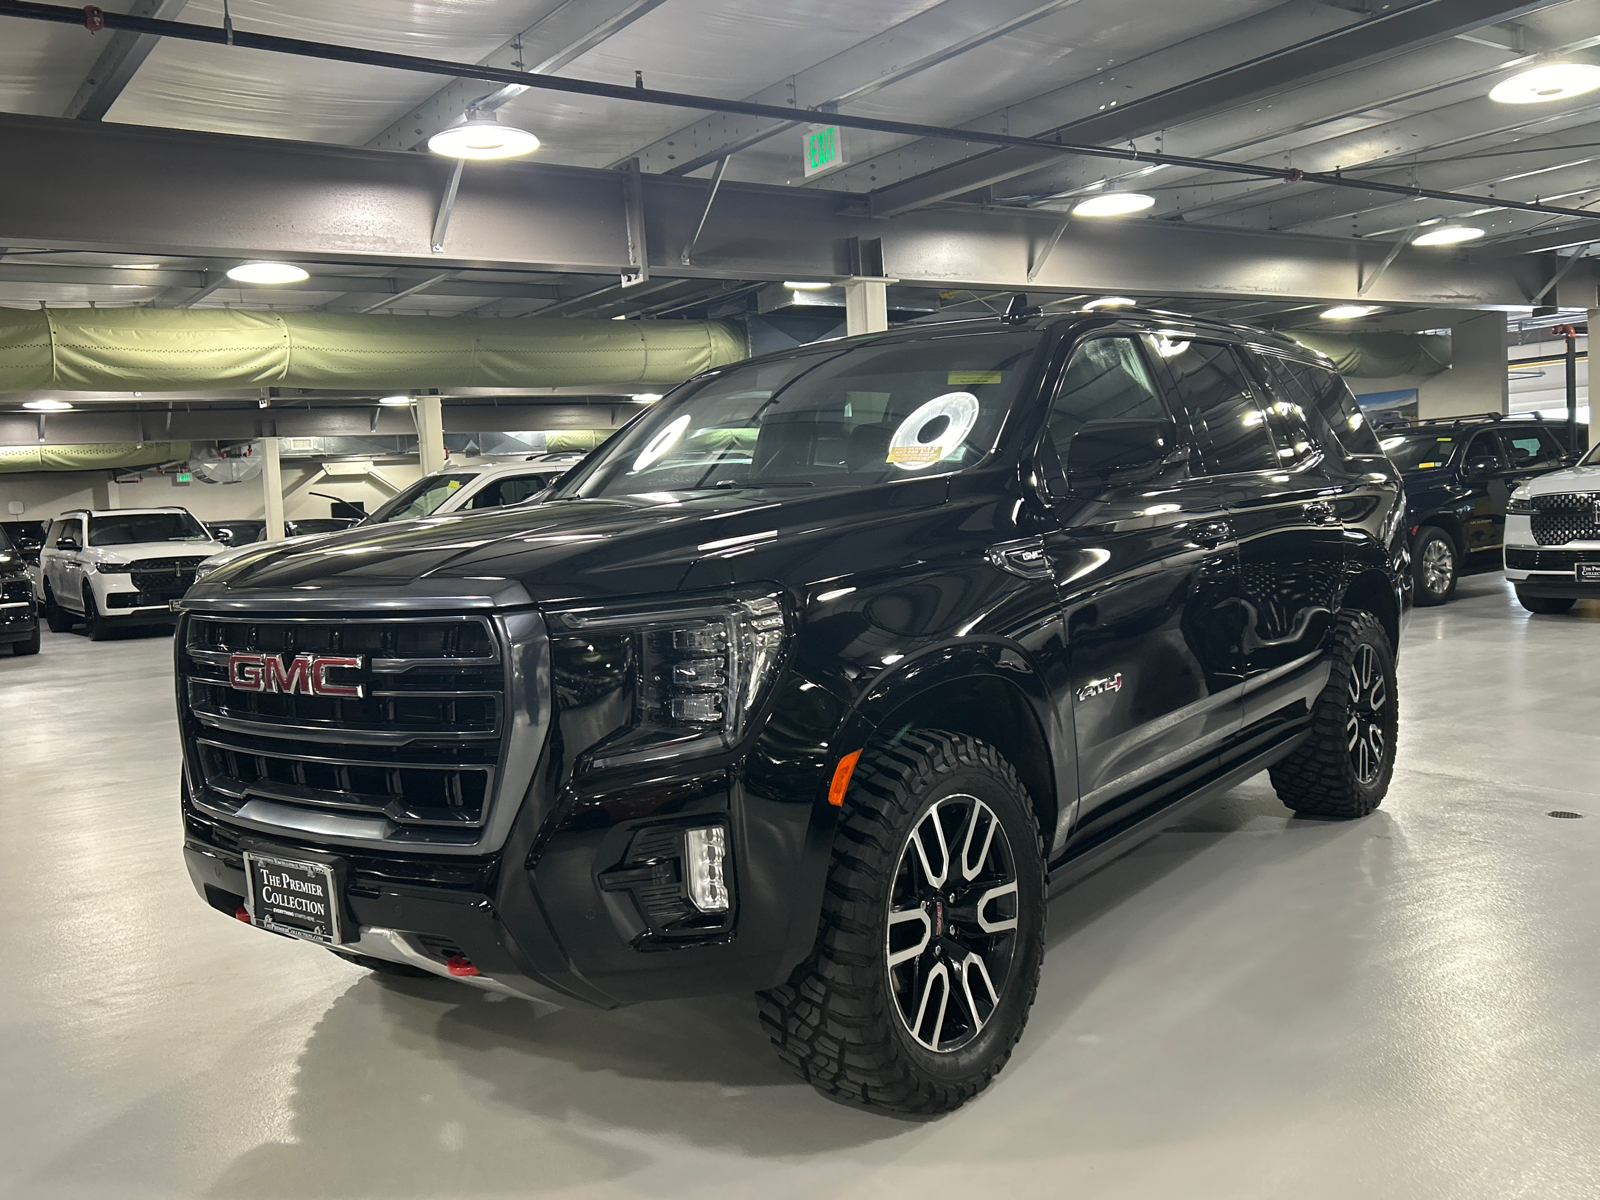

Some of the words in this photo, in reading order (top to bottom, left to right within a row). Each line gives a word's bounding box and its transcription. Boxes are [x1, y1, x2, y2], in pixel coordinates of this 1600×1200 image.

[810, 126, 835, 168] EXIT
[229, 652, 363, 698] GMC
[1076, 672, 1122, 701] AT4
[260, 869, 282, 887] THE
[281, 873, 323, 897] PREMIER
[262, 887, 325, 916] COLLECTION
